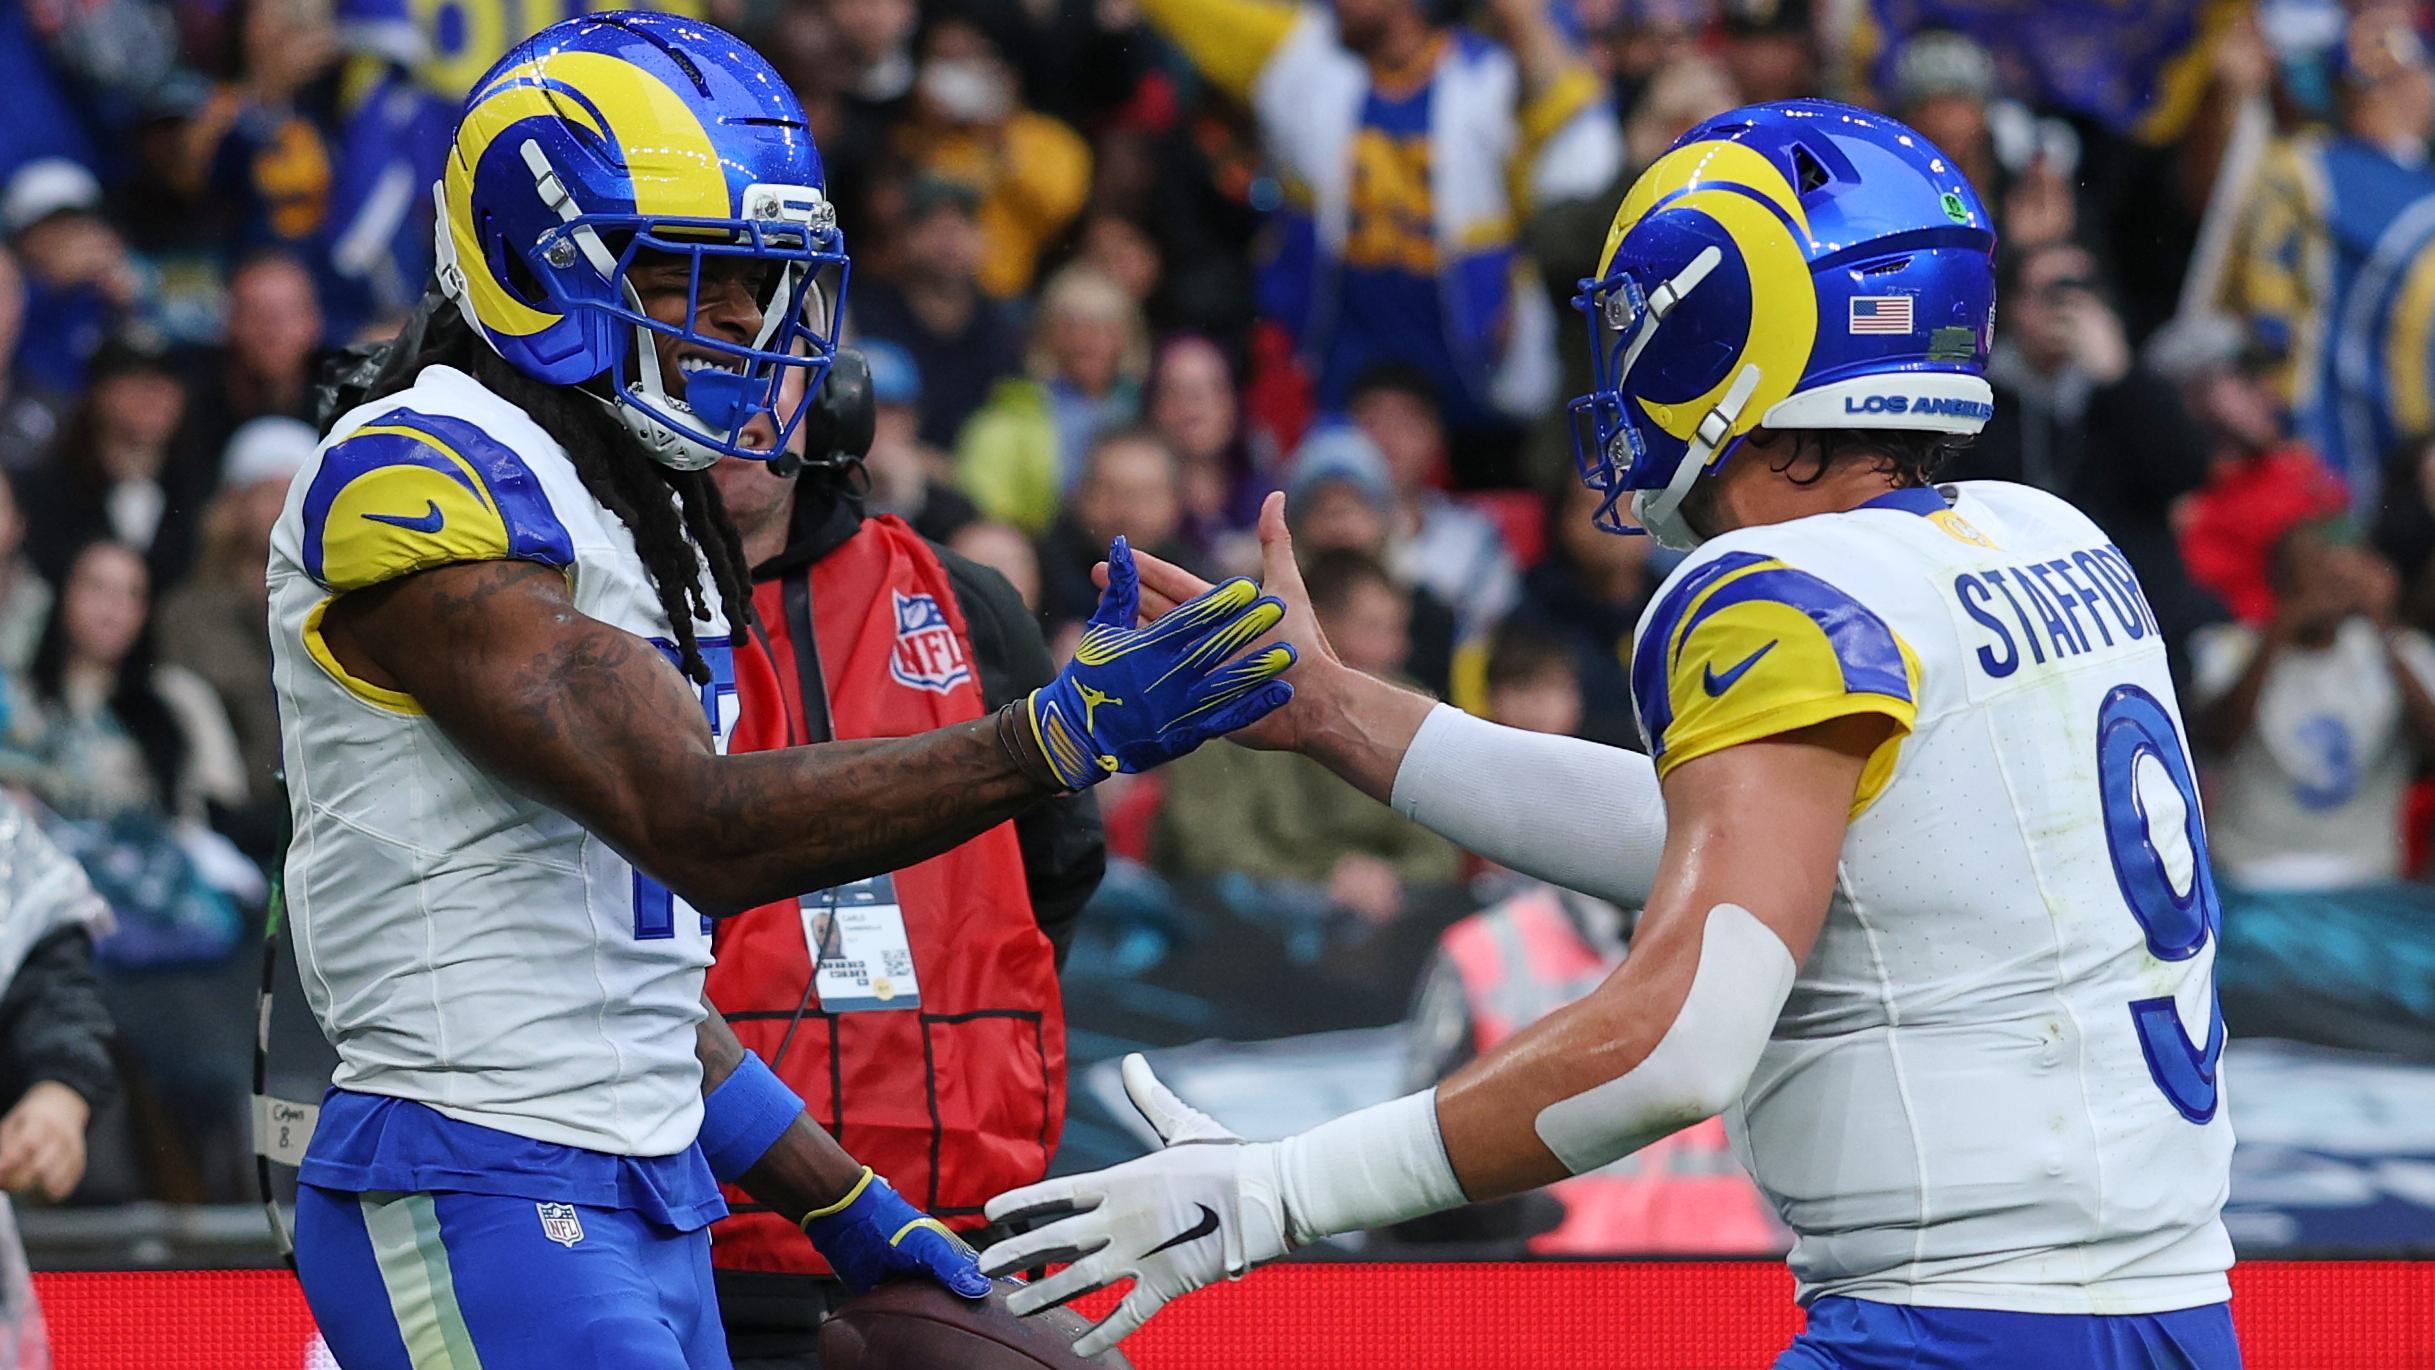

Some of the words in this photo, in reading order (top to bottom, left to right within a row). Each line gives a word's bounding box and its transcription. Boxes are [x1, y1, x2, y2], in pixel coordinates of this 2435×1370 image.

[1845, 396, 1908, 414] LOS
[1955, 544, 2161, 678] STAFFOR
[898, 629, 964, 677] NFL
[2096, 684, 2223, 1125] 9
[547, 1220, 579, 1238] NFL
